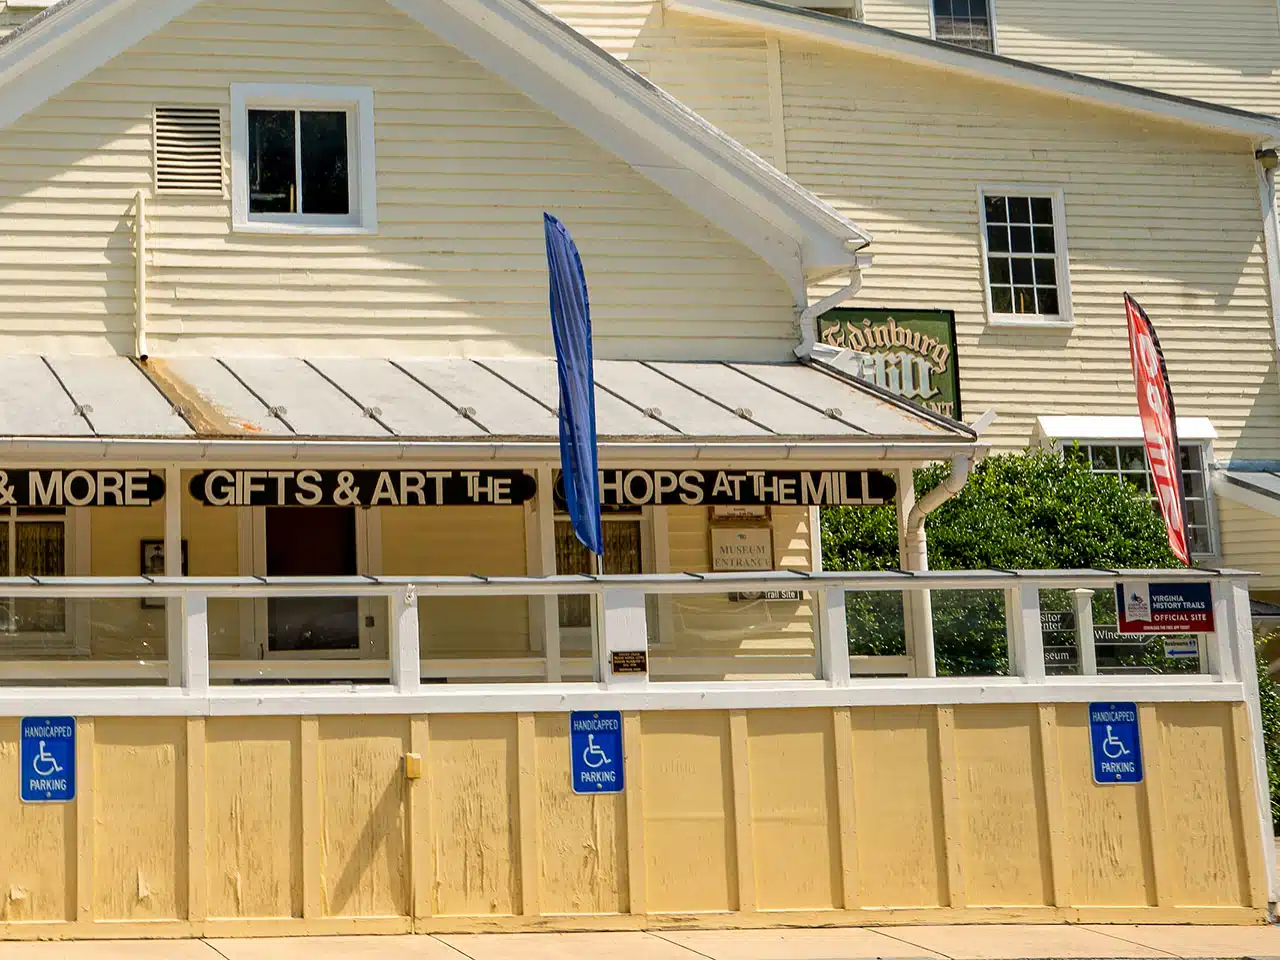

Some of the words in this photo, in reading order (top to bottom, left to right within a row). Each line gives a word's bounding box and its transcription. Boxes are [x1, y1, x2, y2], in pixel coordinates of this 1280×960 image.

[28, 470, 150, 506] MORE
[204, 470, 323, 506] GIFTS
[332, 470, 361, 506] &
[370, 471, 452, 505] ART
[460, 471, 512, 505] THE
[598, 470, 705, 505] HOPS
[712, 471, 746, 501] AT
[747, 471, 797, 504] THE
[801, 471, 884, 505] MILL
[720, 545, 765, 554] MUSEUM
[715, 559, 770, 567] ENTRANCE
[1040, 613, 1061, 621] sitor
[1190, 613, 1207, 621] SITE
[1044, 652, 1070, 660] seum
[1092, 711, 1135, 722] HANDICAPPED
[573, 719, 619, 731] HANDICAPPED
[24, 726, 72, 738] HANDICAPPED
[1101, 762, 1135, 773] PARKING
[581, 771, 616, 782] PARKING
[29, 779, 67, 791] PARKING
